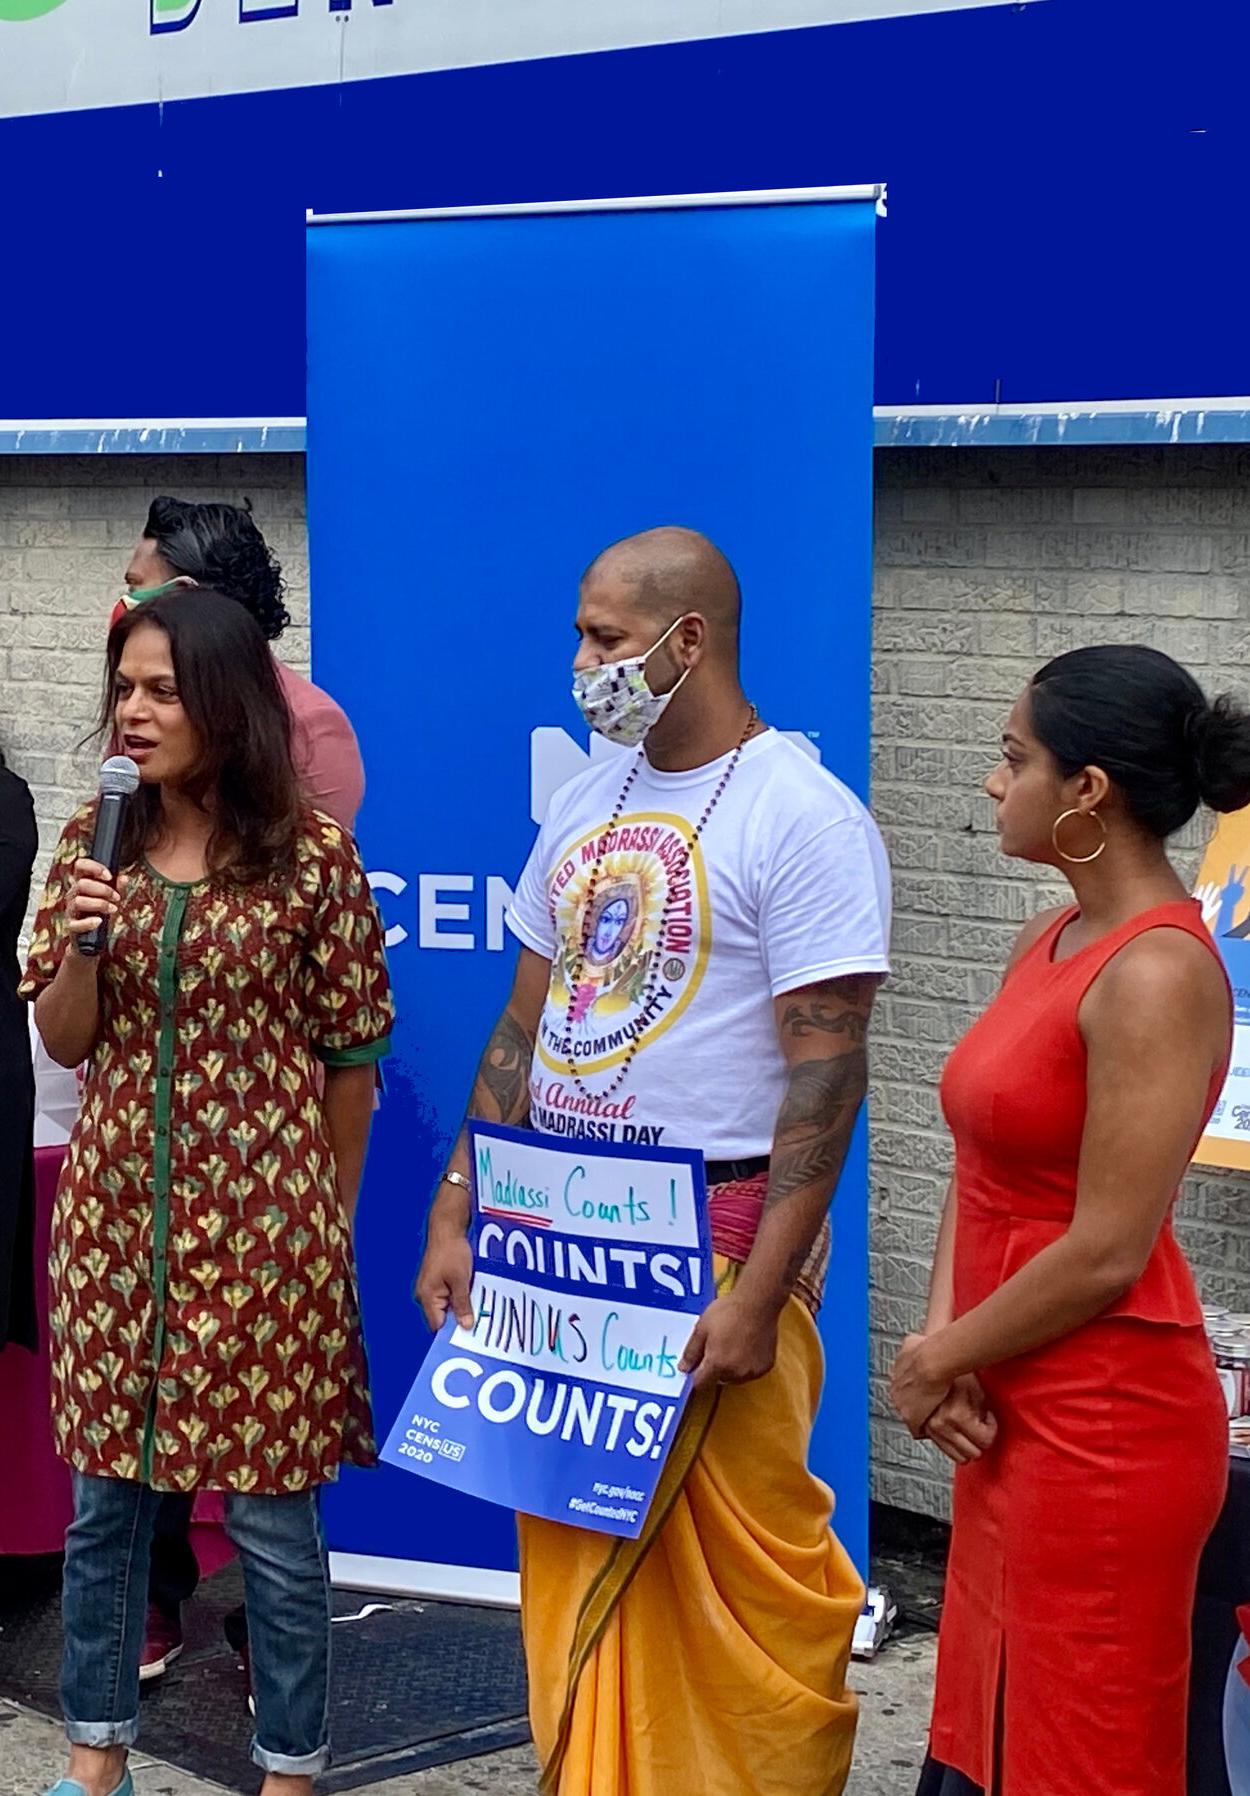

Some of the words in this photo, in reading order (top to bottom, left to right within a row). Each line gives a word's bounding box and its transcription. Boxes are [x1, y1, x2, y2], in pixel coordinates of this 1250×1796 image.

[581, 827, 664, 864] MADRASSI
[547, 1031, 572, 1055] THE
[574, 985, 673, 1057] COMMUNITY
[545, 1082, 637, 1121] Annual
[539, 1111, 616, 1143] MADRASSI
[622, 1125, 666, 1147] DAY
[479, 1147, 550, 1209] Madrassi
[564, 1166, 651, 1225] Counts
[472, 1285, 588, 1363] HINDUS
[602, 1311, 678, 1378] Counts
[412, 1414, 441, 1433] NYC
[431, 1357, 676, 1460] COUNTS!
[398, 1442, 433, 1463] 2020
